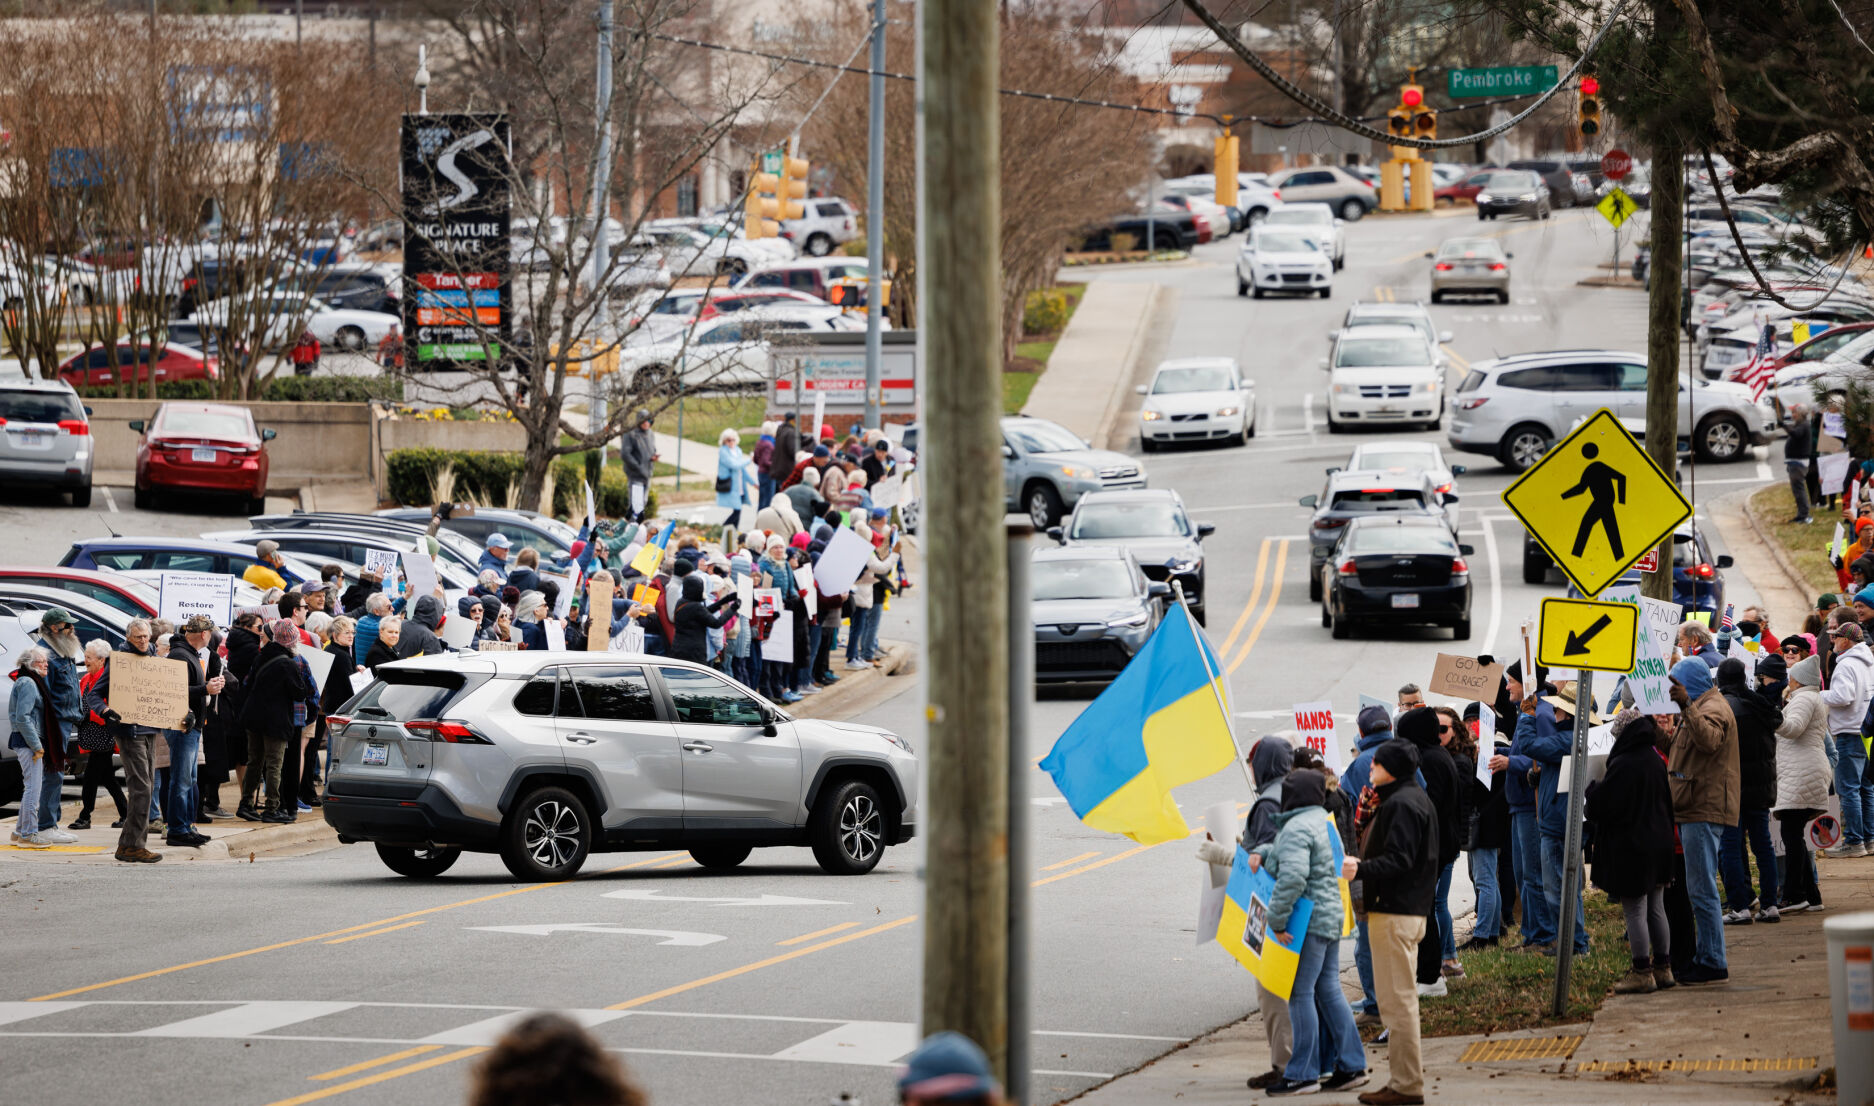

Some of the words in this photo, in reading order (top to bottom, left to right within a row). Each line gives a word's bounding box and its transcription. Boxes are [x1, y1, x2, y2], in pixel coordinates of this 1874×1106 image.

[1453, 70, 1533, 89] Pembroke
[416, 222, 500, 238] SIGNATURE
[434, 239, 481, 253] PLACE
[850, 379, 866, 390] CA
[178, 601, 215, 609] Restore
[1653, 629, 1669, 642] TO
[1455, 657, 1481, 673] GOT
[1445, 671, 1489, 688] COURAGE?
[1295, 709, 1334, 732] HANDS
[1305, 735, 1327, 756] OFF
